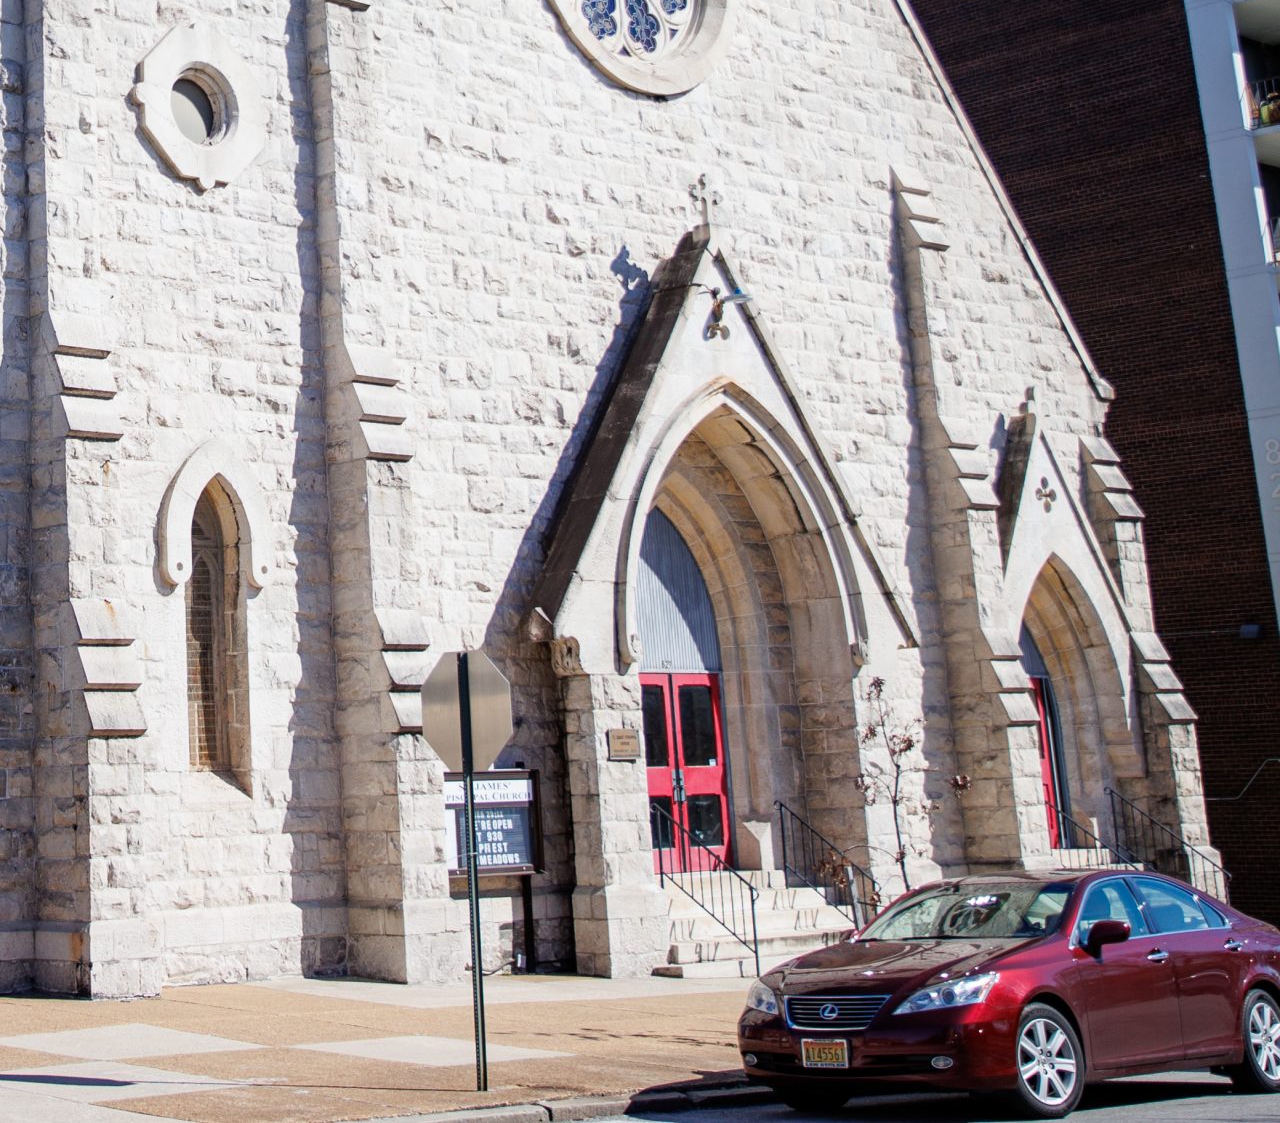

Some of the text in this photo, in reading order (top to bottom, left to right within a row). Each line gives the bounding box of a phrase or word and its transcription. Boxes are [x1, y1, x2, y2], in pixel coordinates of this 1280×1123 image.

[492, 791, 531, 800] CHURCH
[492, 818, 513, 830] OPEN
[486, 831, 504, 842] 930
[479, 853, 520, 866] MEADOWS
